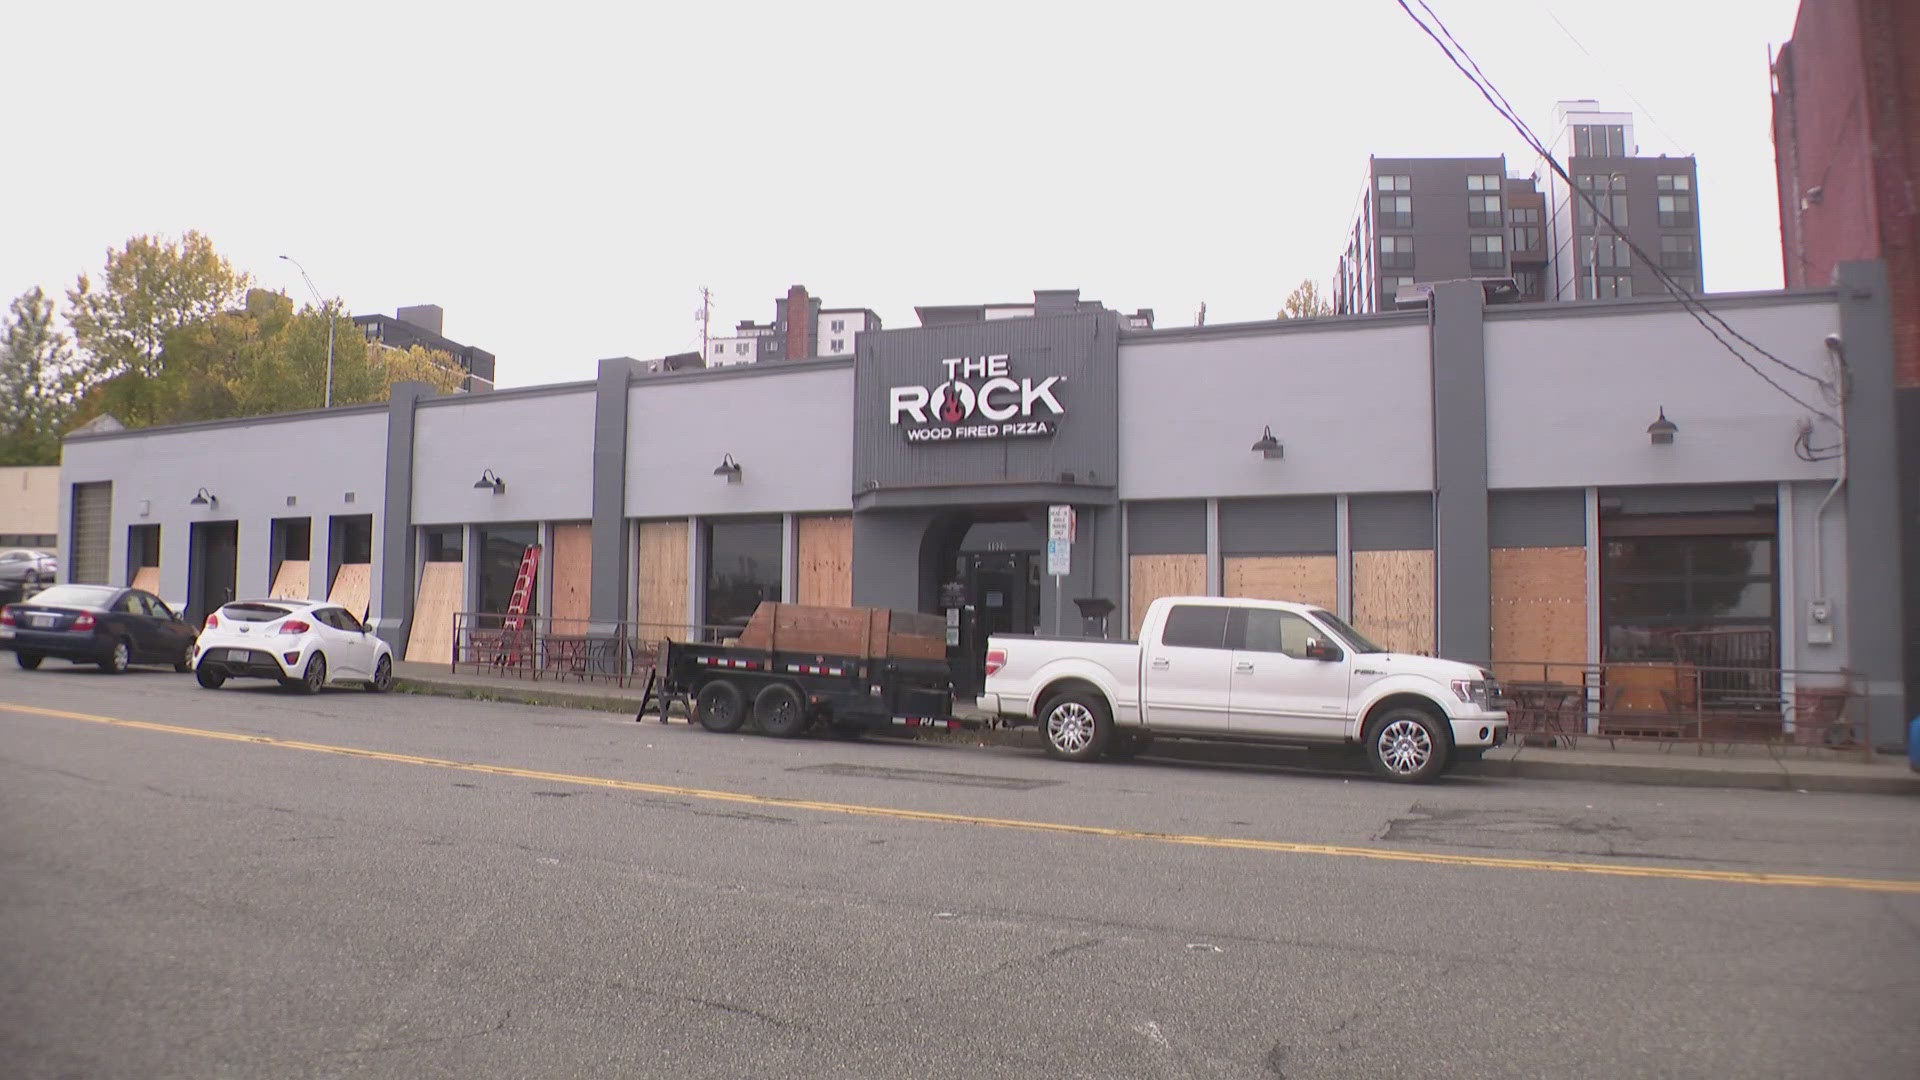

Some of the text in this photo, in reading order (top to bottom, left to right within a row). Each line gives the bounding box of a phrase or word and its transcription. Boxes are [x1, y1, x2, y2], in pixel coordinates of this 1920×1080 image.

[942, 354, 1009, 379] THE
[889, 376, 1065, 425] ROCK
[907, 421, 1048, 441] WOOD FIRED PIZZA
